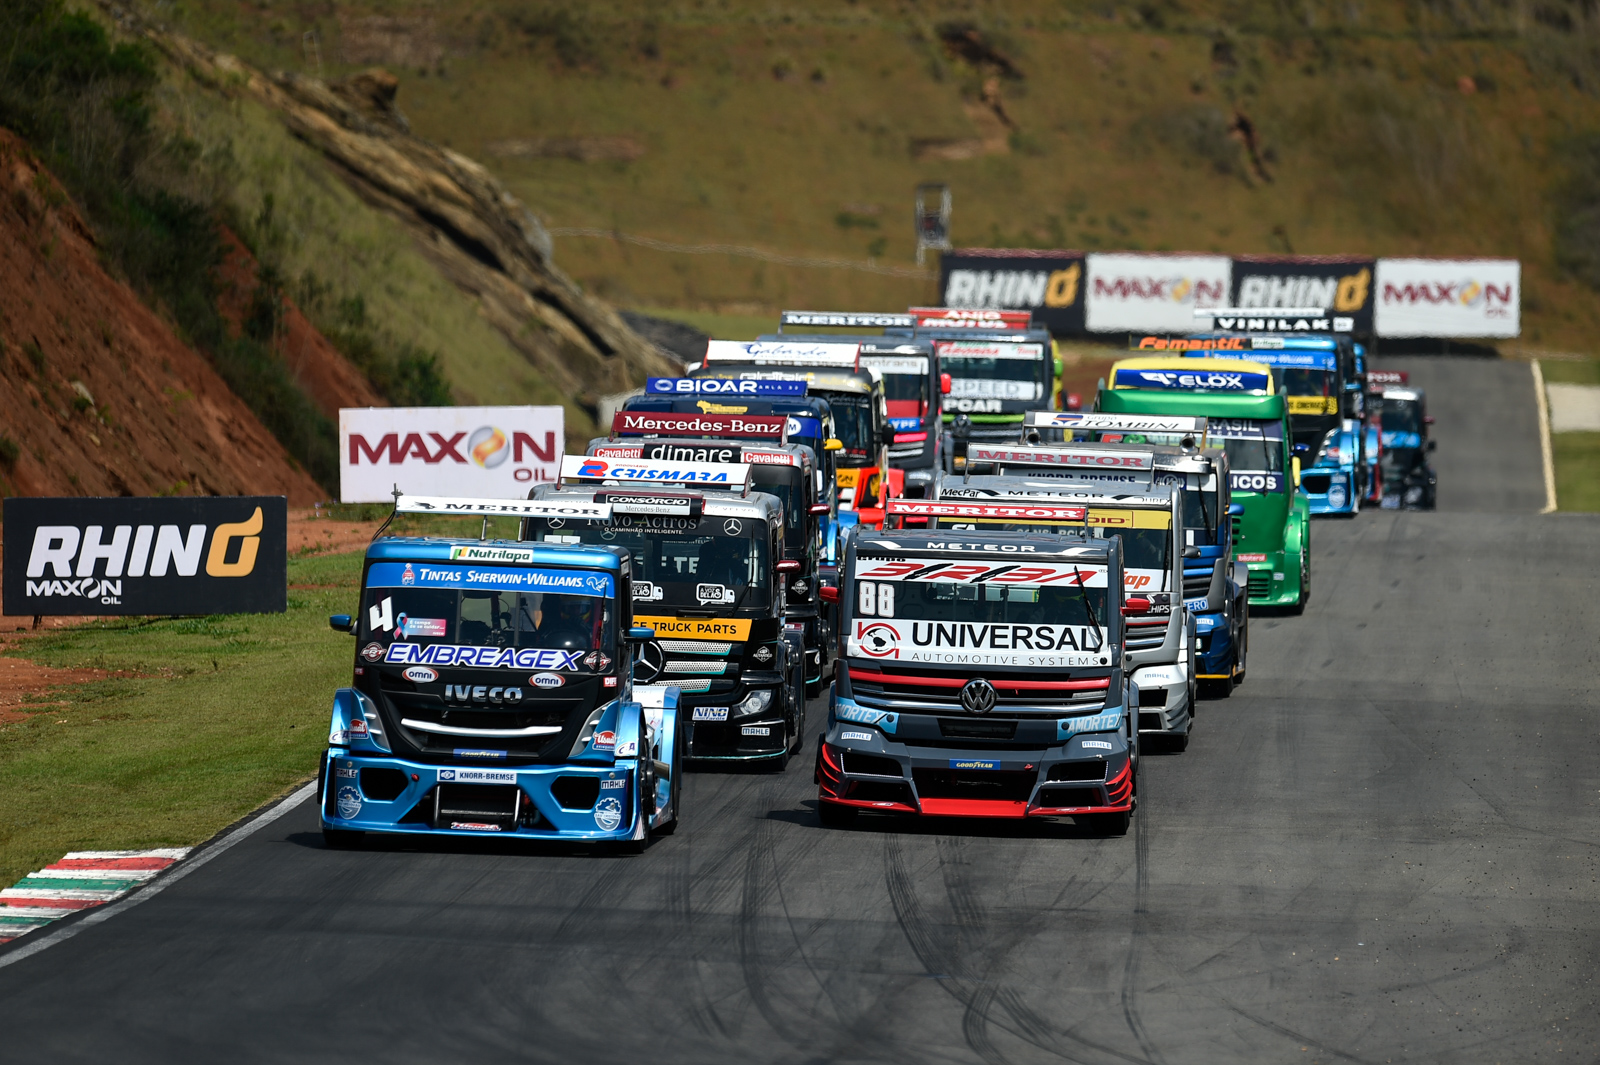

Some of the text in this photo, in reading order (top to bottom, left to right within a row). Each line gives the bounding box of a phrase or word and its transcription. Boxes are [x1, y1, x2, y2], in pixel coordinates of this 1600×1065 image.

[946, 262, 1081, 308] RHINO
[1094, 275, 1223, 305] MAXON
[1384, 279, 1511, 307] MAXON
[786, 315, 912, 326] MERITOR
[1218, 317, 1331, 330] VINILAK
[676, 379, 757, 393] BIOAR
[623, 415, 781, 434] Mercedes-Benz
[1085, 420, 1180, 429] TOMBINI
[1206, 419, 1260, 432] RASIL
[349, 425, 556, 470] MAXON
[596, 447, 641, 459] Cavaletti
[650, 444, 733, 463] dimare
[745, 452, 790, 464] Cavaletti
[975, 450, 1144, 467] MERITOR
[513, 468, 555, 482] OIL
[610, 468, 728, 482] CRISMARA
[1231, 475, 1277, 490] ICOS
[609, 496, 687, 505] CONSÓRCIO
[941, 488, 981, 499] MecPar
[1008, 490, 1104, 499] METEOR
[445, 502, 601, 516] MERITOR
[624, 505, 671, 514] Mercedes-Benz
[894, 503, 1080, 519] MERITOR
[637, 515, 697, 530] Actros
[26, 506, 264, 578] RHINO
[927, 541, 1036, 552] METEOR
[467, 549, 531, 563] Nutrilapa
[420, 568, 461, 582] TINTAS
[26, 578, 122, 599] MAXON
[101, 596, 122, 605] OIL
[859, 581, 896, 618] 88
[369, 596, 394, 632] 4
[653, 622, 692, 632] TRUCK
[697, 623, 737, 635] PARTS
[912, 622, 1098, 651] UNIVERSAL
[385, 642, 585, 672] EMBREAGEX
[912, 652, 1099, 666] AUTOMOTIVE SYSTEMS
[408, 670, 432, 680] omni
[535, 676, 559, 686] omni
[444, 684, 523, 704] IVECO
[1067, 713, 1122, 733] AMORTEX
[842, 732, 871, 740] MAHLE
[956, 761, 994, 769] GOODYEAR
[459, 772, 515, 781] KNORR-BREMSE
